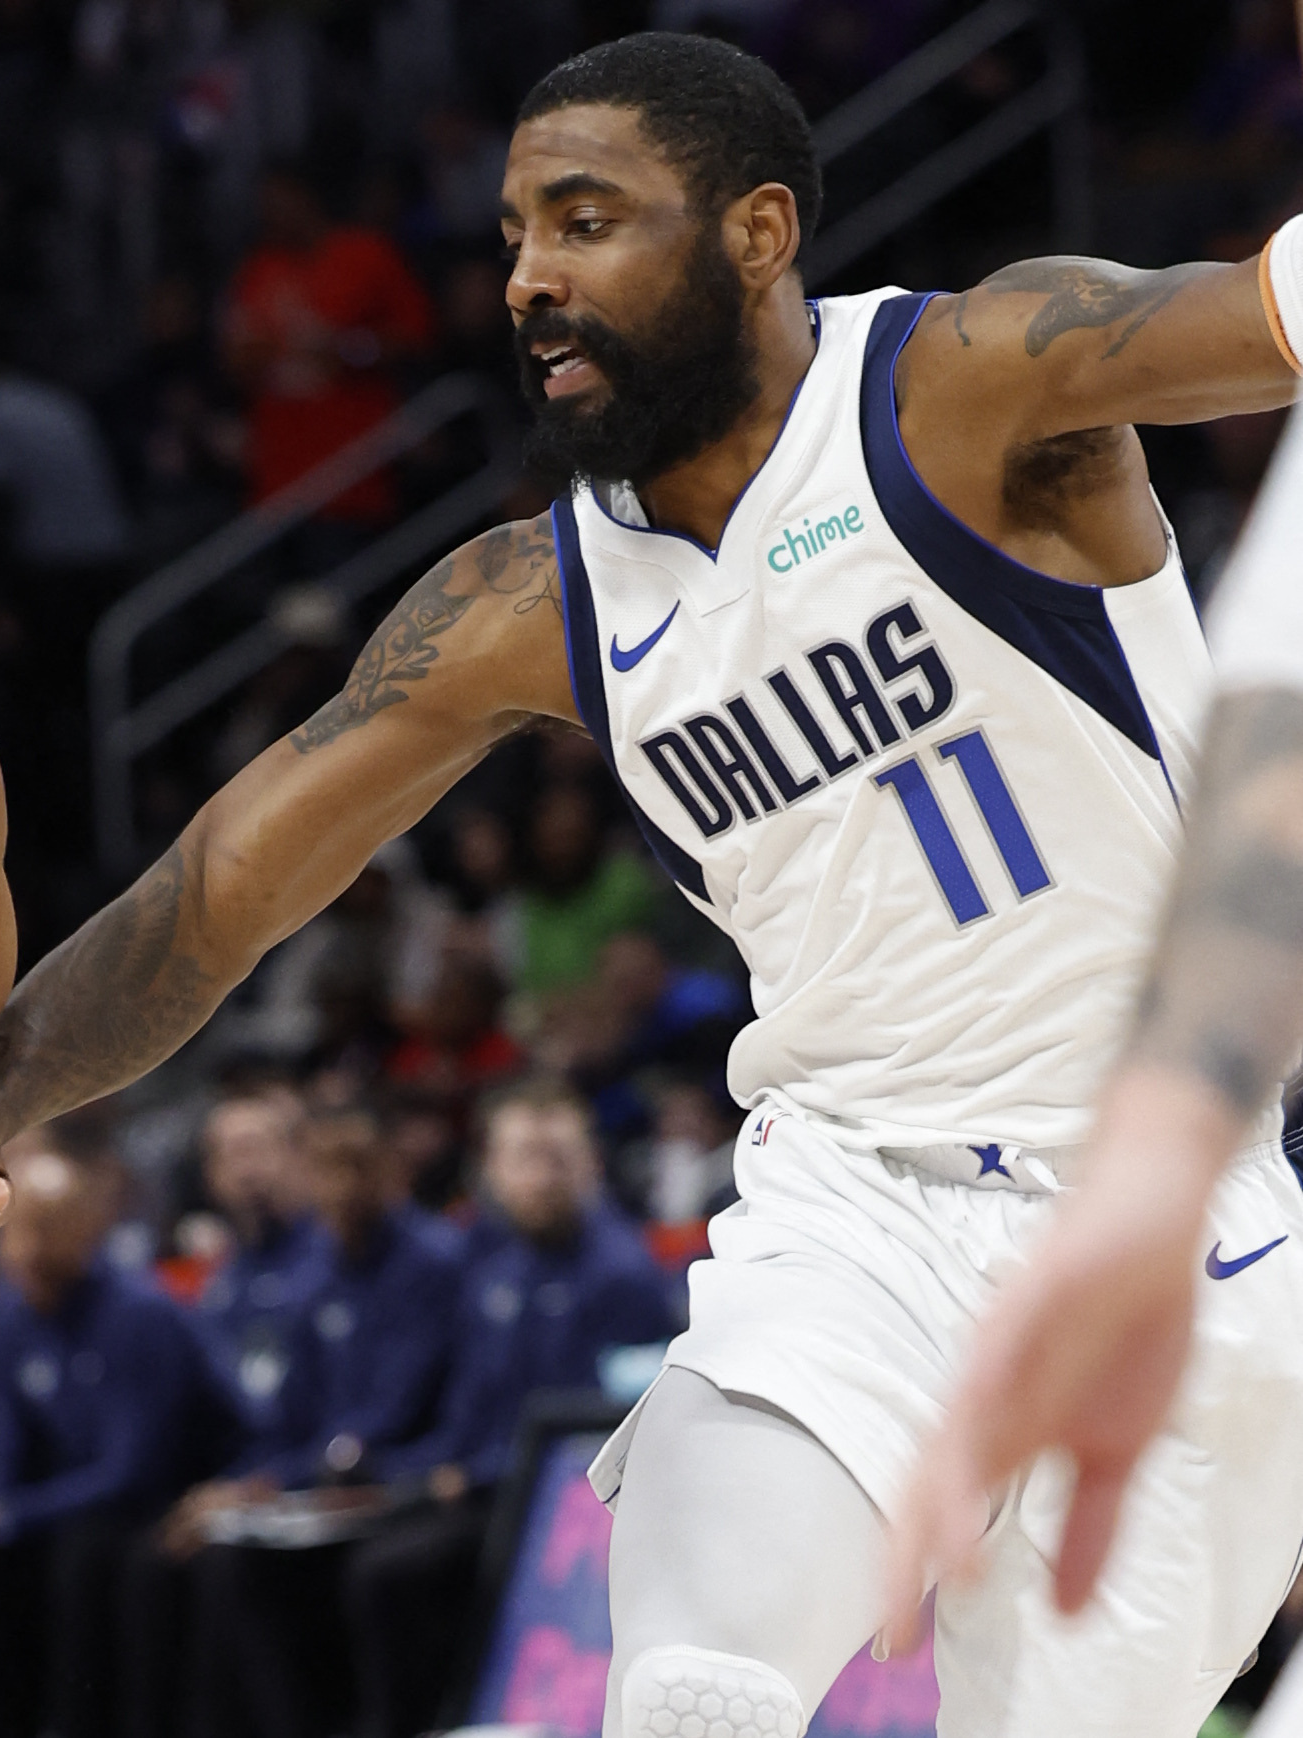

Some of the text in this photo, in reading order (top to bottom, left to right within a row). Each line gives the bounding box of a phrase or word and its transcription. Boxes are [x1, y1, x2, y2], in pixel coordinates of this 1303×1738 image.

[767, 503, 865, 575] chime
[637, 598, 957, 843] DALLAS
[870, 725, 1056, 930] 11
